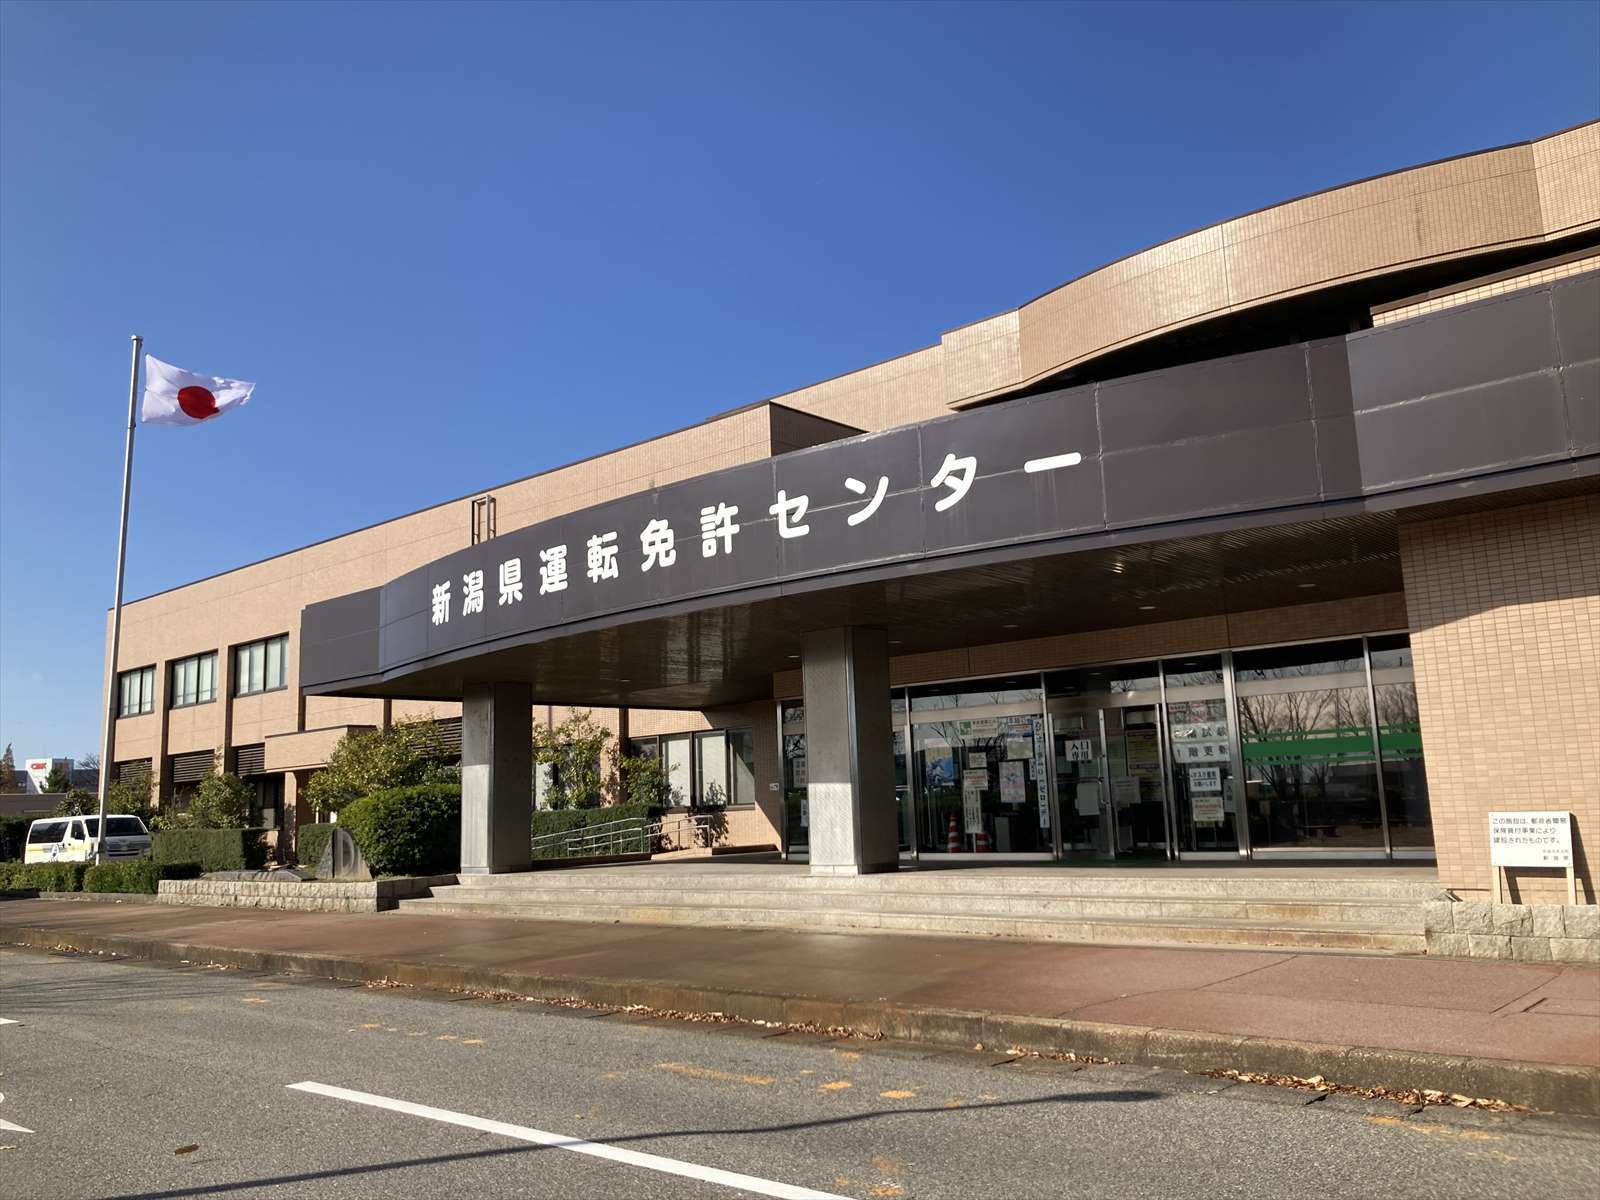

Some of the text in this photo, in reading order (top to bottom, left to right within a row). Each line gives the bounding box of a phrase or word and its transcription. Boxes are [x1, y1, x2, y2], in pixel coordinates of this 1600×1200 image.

[431, 452, 1082, 627] 新潟県運転免許センター
